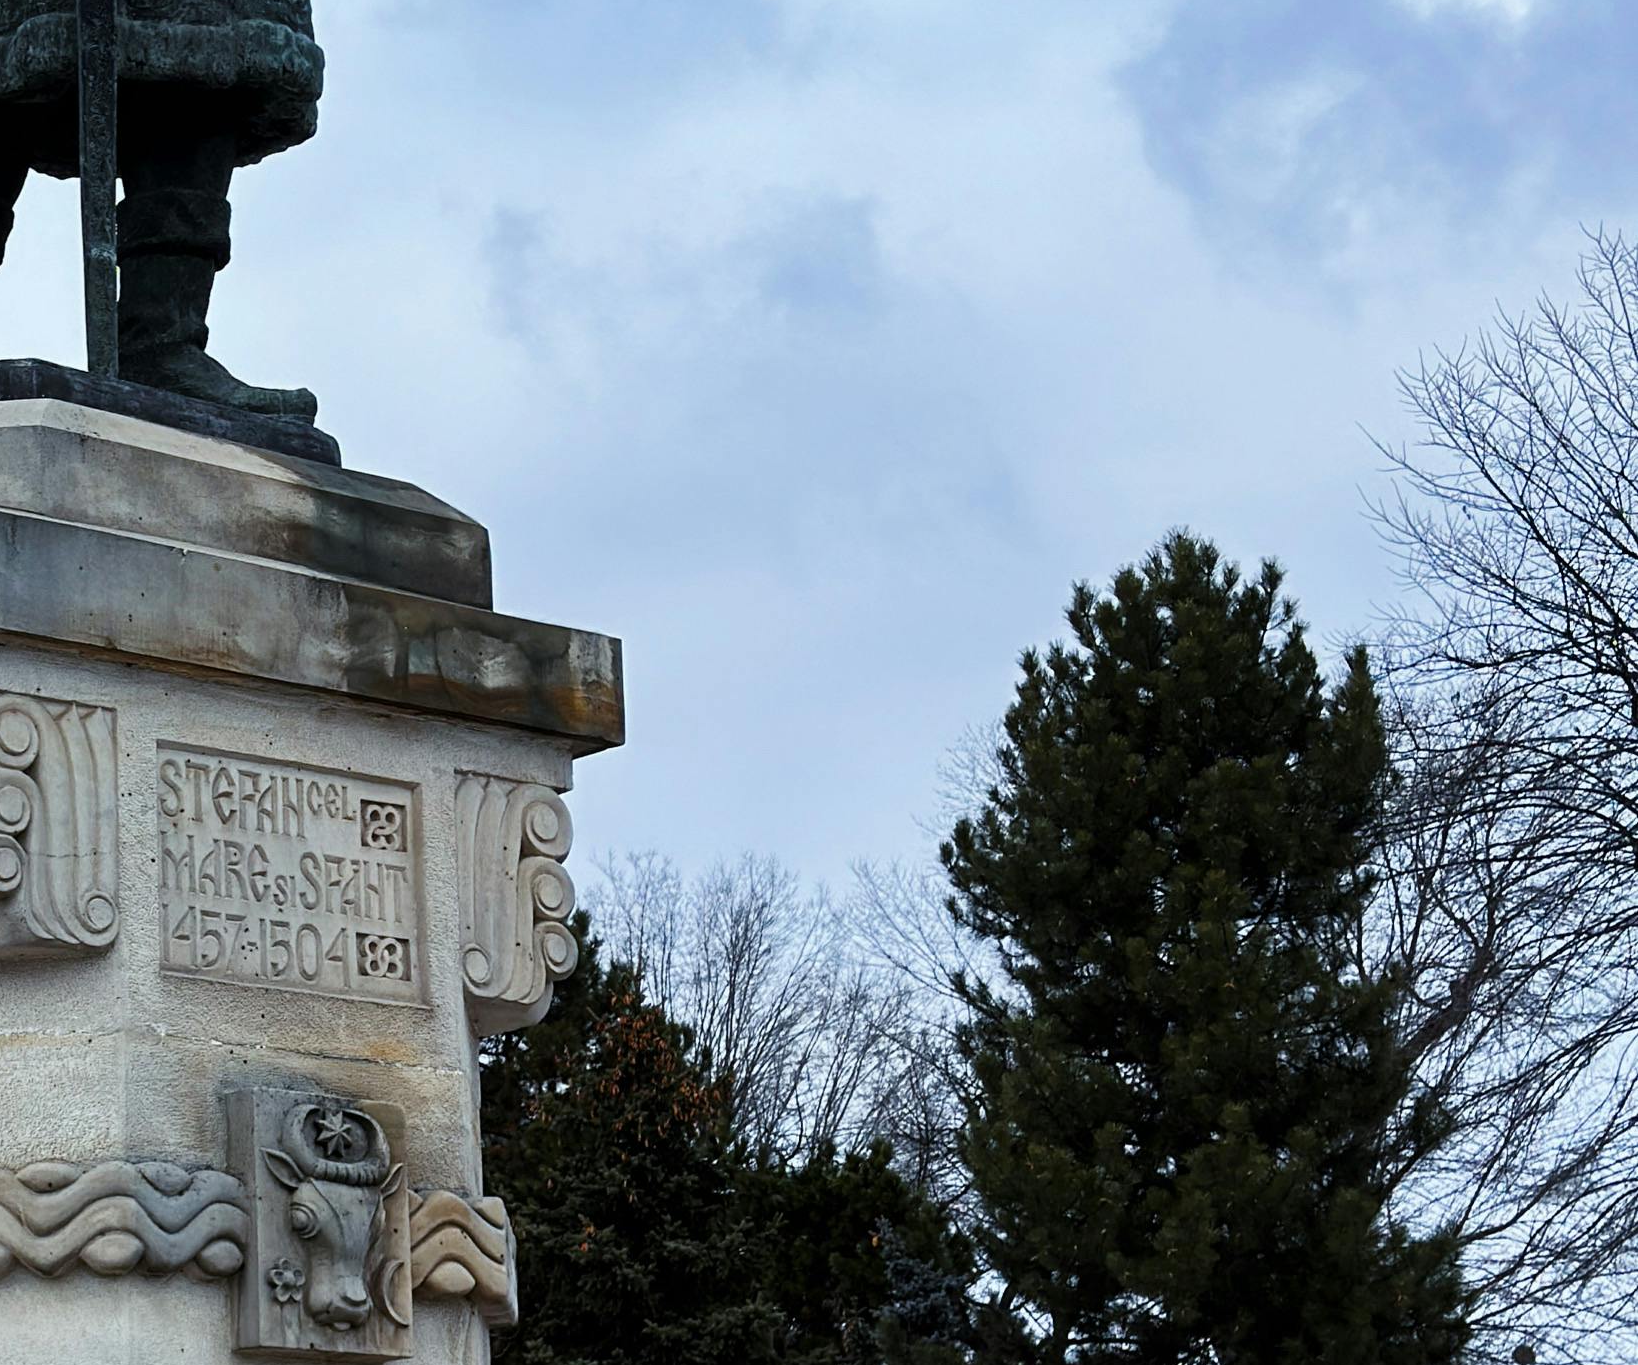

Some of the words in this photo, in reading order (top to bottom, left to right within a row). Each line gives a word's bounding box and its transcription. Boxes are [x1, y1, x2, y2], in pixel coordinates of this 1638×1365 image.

[307, 781, 357, 821] CEL
[160, 830, 270, 902] MARE
[161, 903, 352, 989] 1457-1504
